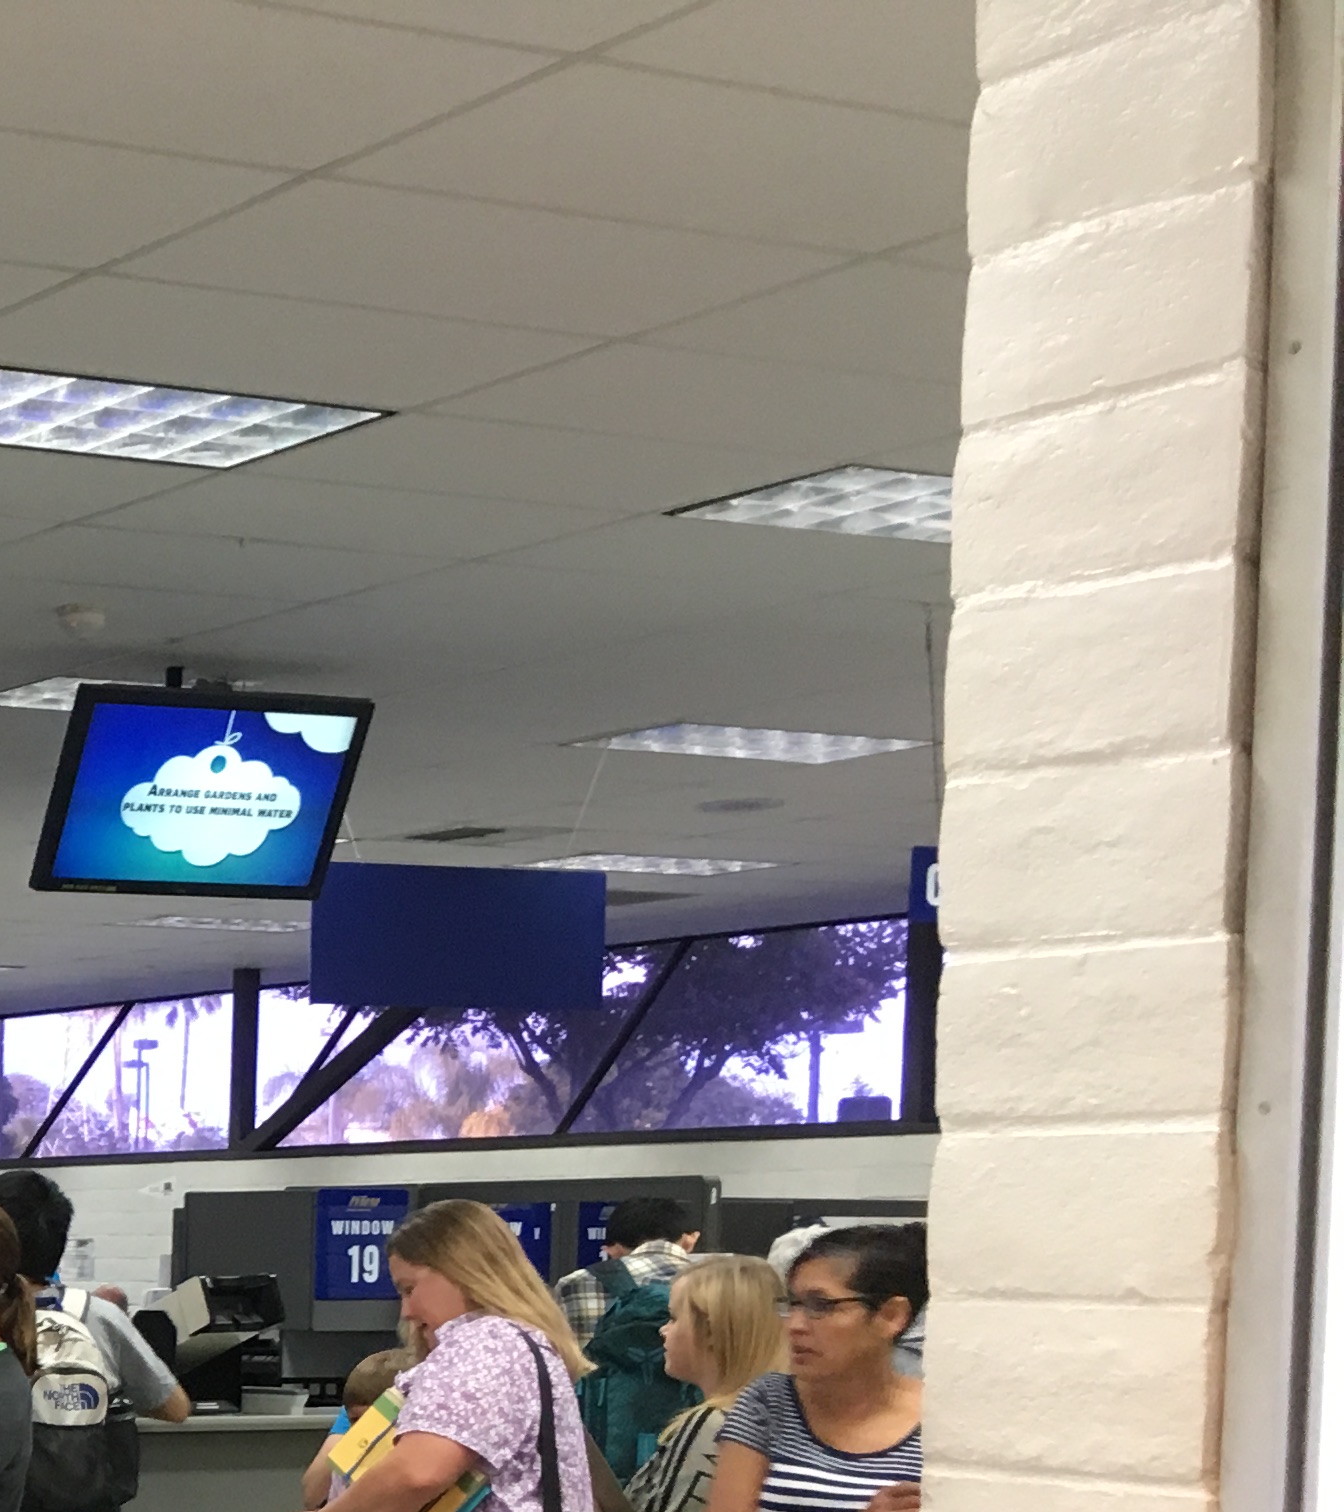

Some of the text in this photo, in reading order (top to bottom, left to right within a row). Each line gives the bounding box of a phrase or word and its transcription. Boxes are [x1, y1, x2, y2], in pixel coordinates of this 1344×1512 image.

[331, 1220, 394, 1236] WINDOW
[347, 1244, 380, 1284] 19
[54, 1401, 81, 1411] FACE
